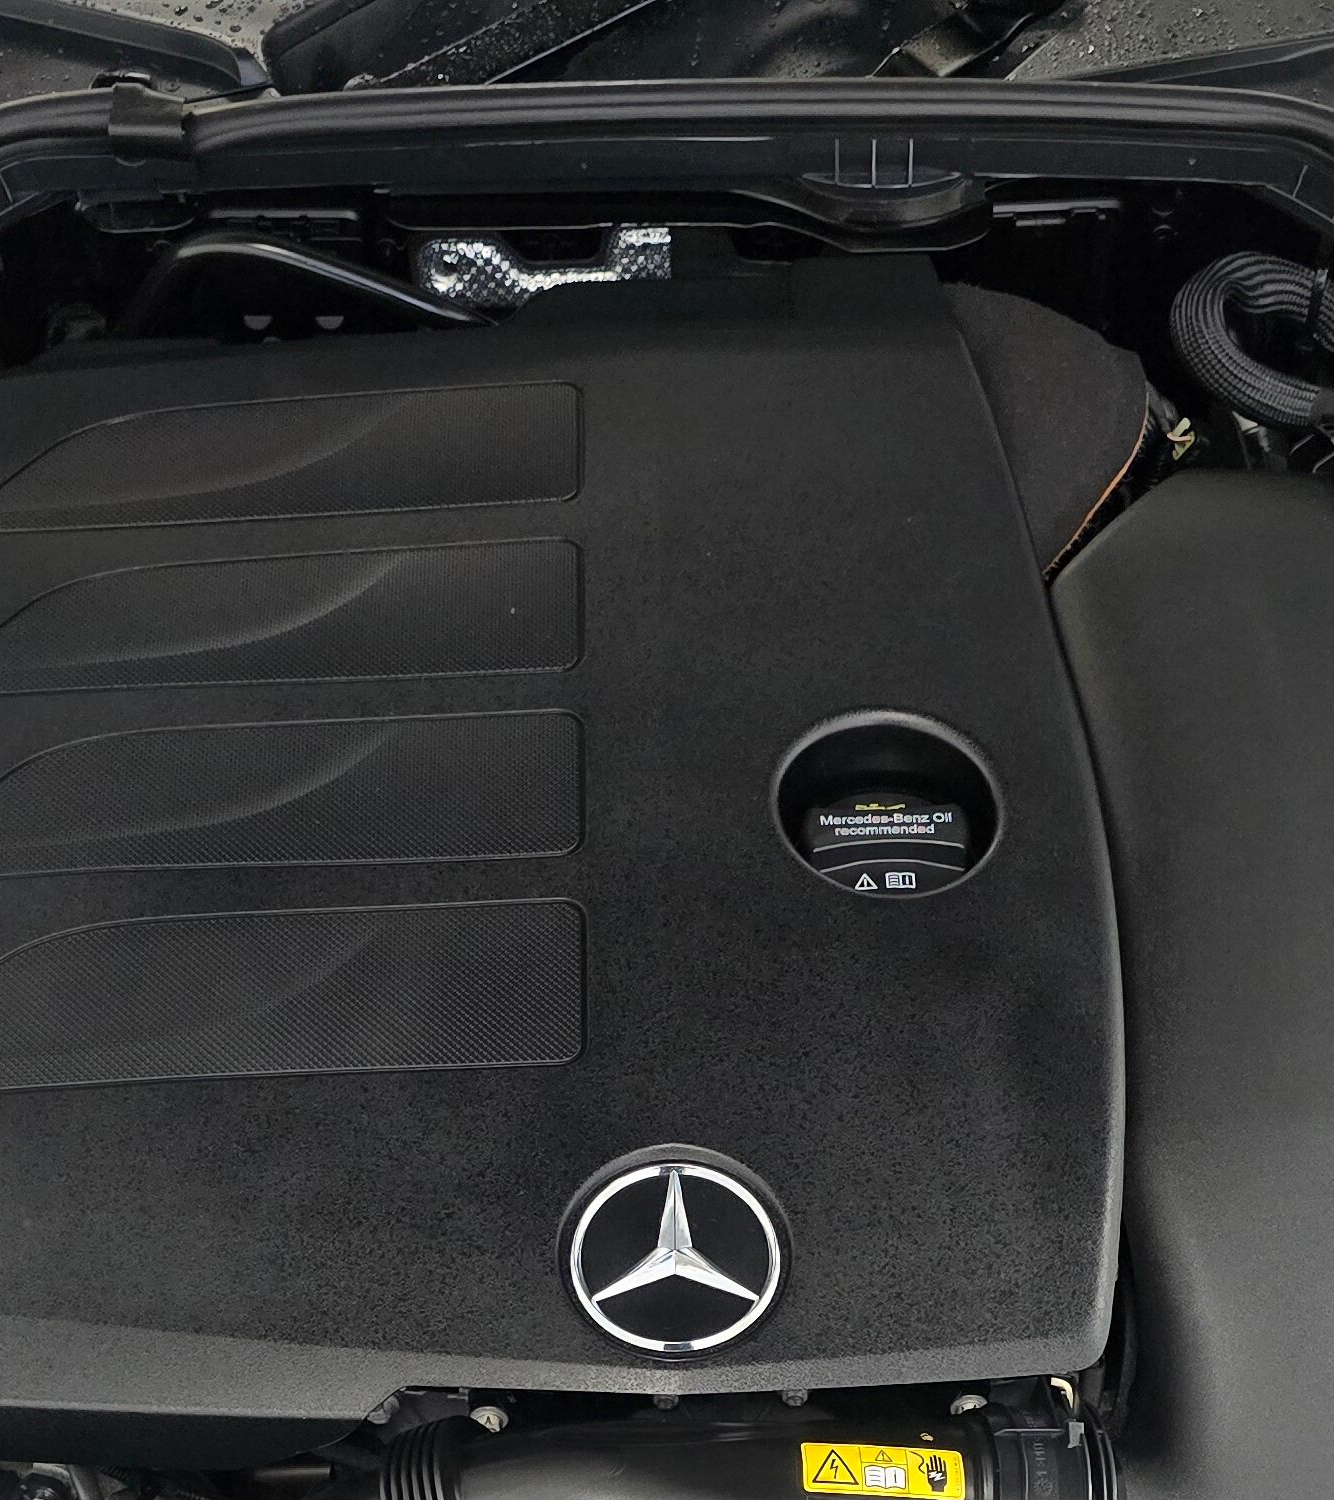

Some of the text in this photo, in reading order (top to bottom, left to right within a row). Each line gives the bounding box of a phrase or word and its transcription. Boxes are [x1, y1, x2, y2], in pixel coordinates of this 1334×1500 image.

[819, 812, 953, 826] Mercedes-Benz Oil
[834, 825, 935, 836] recommended
